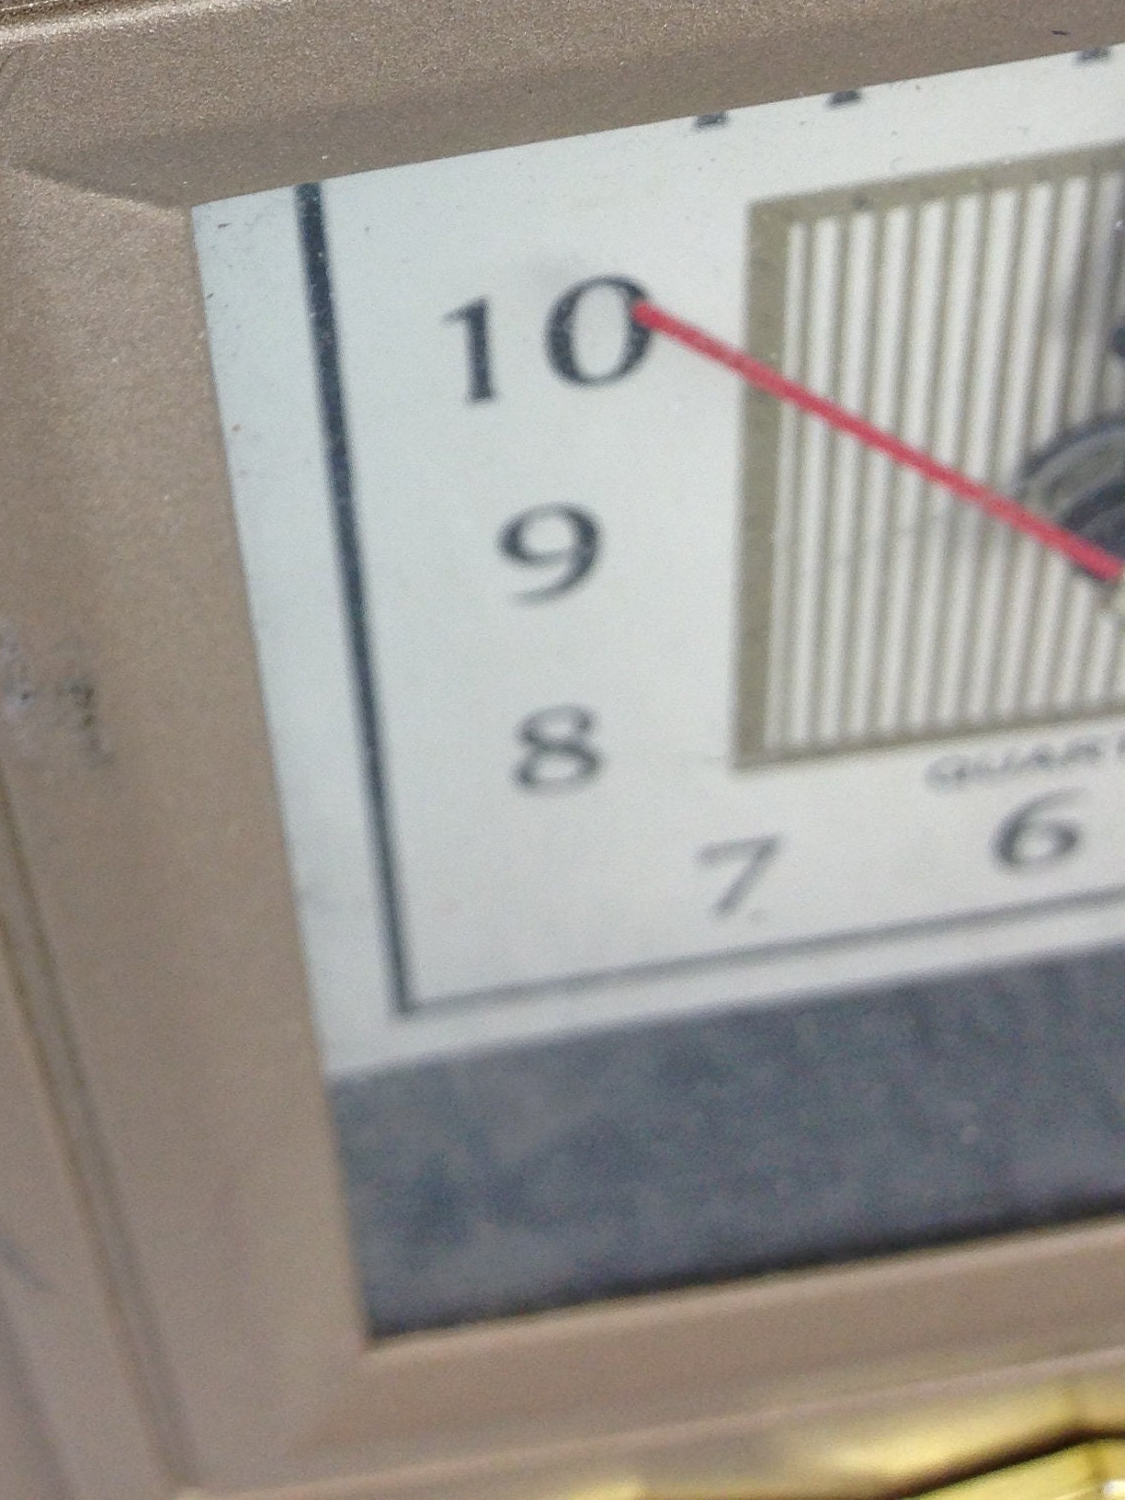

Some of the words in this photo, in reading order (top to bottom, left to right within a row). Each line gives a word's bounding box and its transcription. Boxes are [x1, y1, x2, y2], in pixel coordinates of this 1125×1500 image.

[441, 274, 657, 406] 10
[496, 502, 603, 604] 9
[511, 704, 604, 796] 8
[925, 732, 1125, 794] QUAR
[696, 834, 781, 918] 7
[988, 787, 1086, 875] 6
